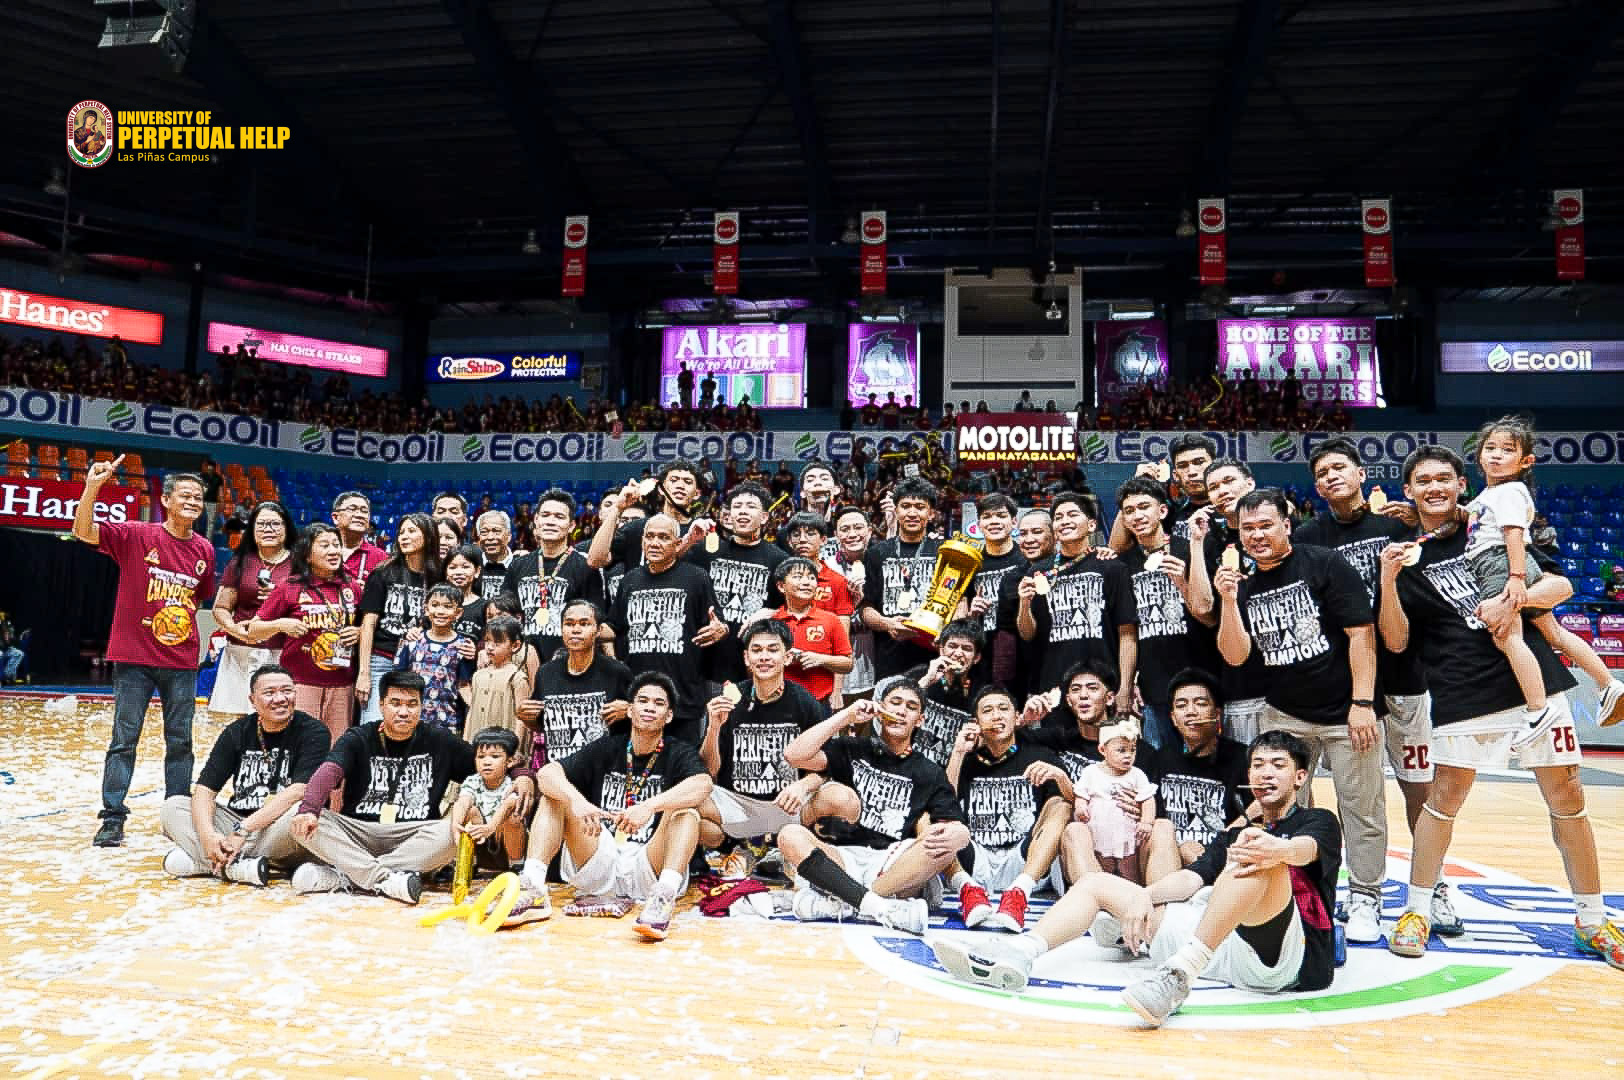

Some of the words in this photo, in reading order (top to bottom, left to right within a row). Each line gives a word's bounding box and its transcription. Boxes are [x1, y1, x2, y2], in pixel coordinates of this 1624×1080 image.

[675, 324, 790, 359] Akari
[1225, 326, 1289, 343] HOME
[1293, 326, 1322, 342] OF
[1327, 326, 1371, 342] THE
[511, 368, 566, 377] PROTECTION
[512, 355, 567, 369] Colorful
[1224, 343, 1371, 380] AKARI
[1512, 350, 1592, 371] EcoOil
[144, 405, 280, 449] EcoOil
[959, 425, 1075, 451] MOTOLITE
[331, 426, 445, 462] EcoOil
[489, 433, 604, 462] EcoOil
[652, 431, 775, 461] EcoOil
[1115, 432, 1248, 462] EcOil
[1367, 465, 1385, 479] ER
[1552, 726, 1576, 753] 26
[1402, 744, 1429, 769] 20
[733, 779, 790, 794] CHAMPIO
[356, 801, 430, 819] CHAIONS
